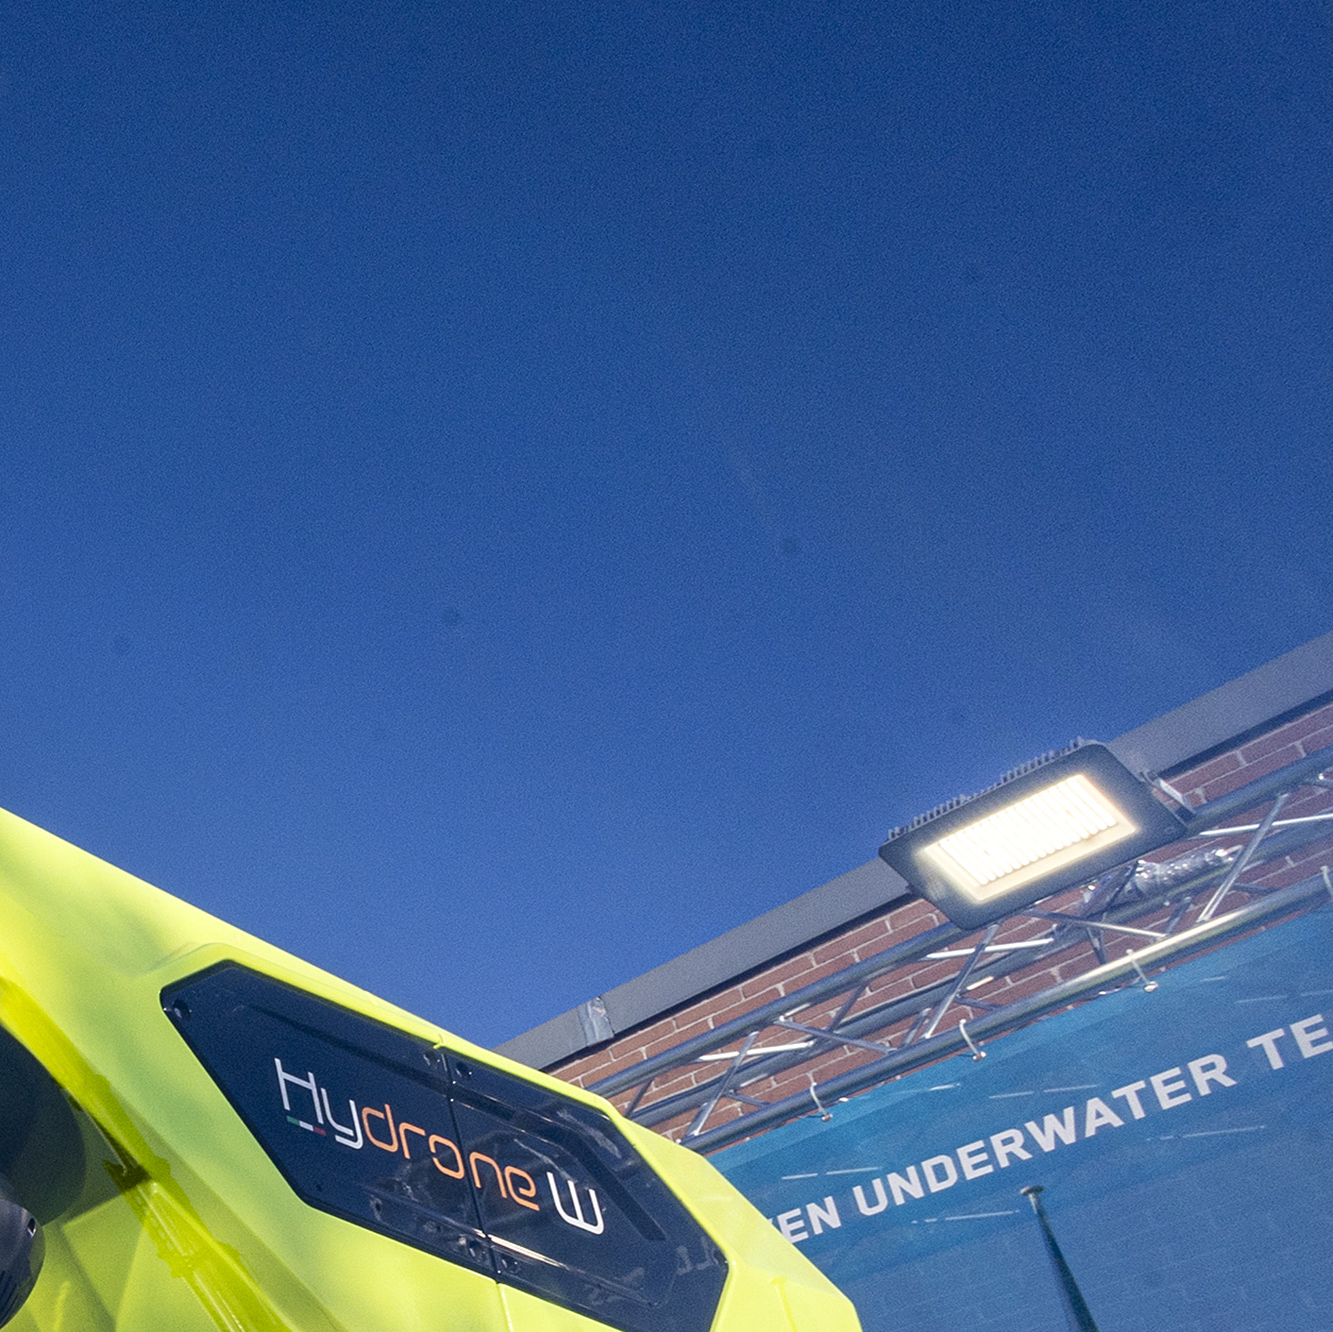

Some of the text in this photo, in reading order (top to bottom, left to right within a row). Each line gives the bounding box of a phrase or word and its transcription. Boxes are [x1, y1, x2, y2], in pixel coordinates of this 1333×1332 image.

[767, 1013, 1333, 1245] EN UNDERWATER TE
